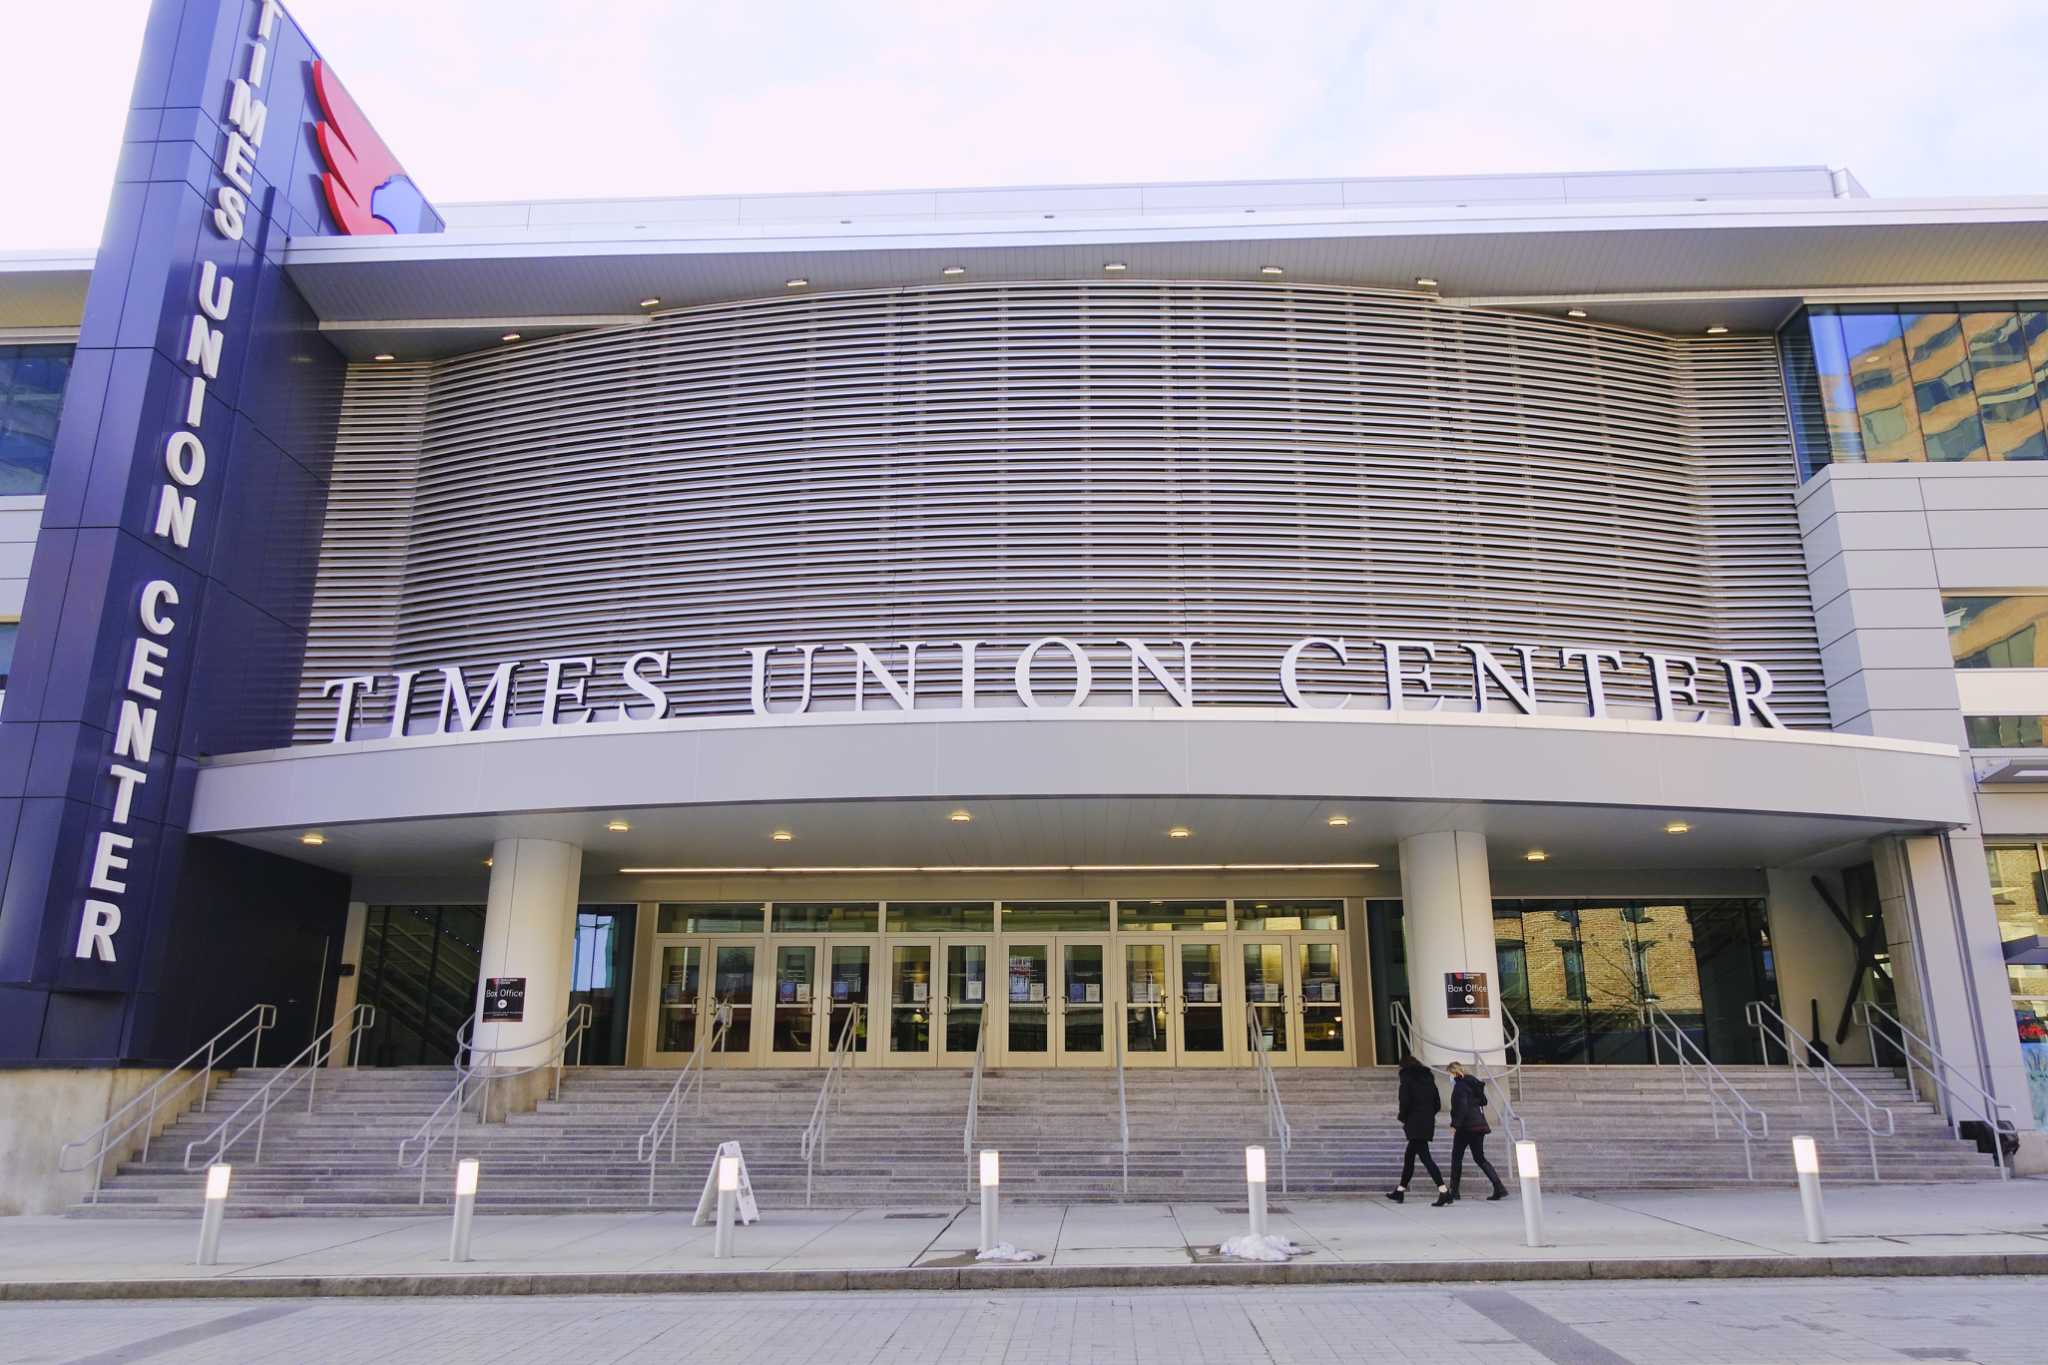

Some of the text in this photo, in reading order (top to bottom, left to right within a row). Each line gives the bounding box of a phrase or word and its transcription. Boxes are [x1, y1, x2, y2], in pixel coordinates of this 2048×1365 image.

[75, 0, 283, 963] TIMES UNION CENTER
[322, 635, 1787, 744] TIMES UNION CENTER
[486, 988, 524, 998] Box Office
[1447, 983, 1488, 993] Box Office
